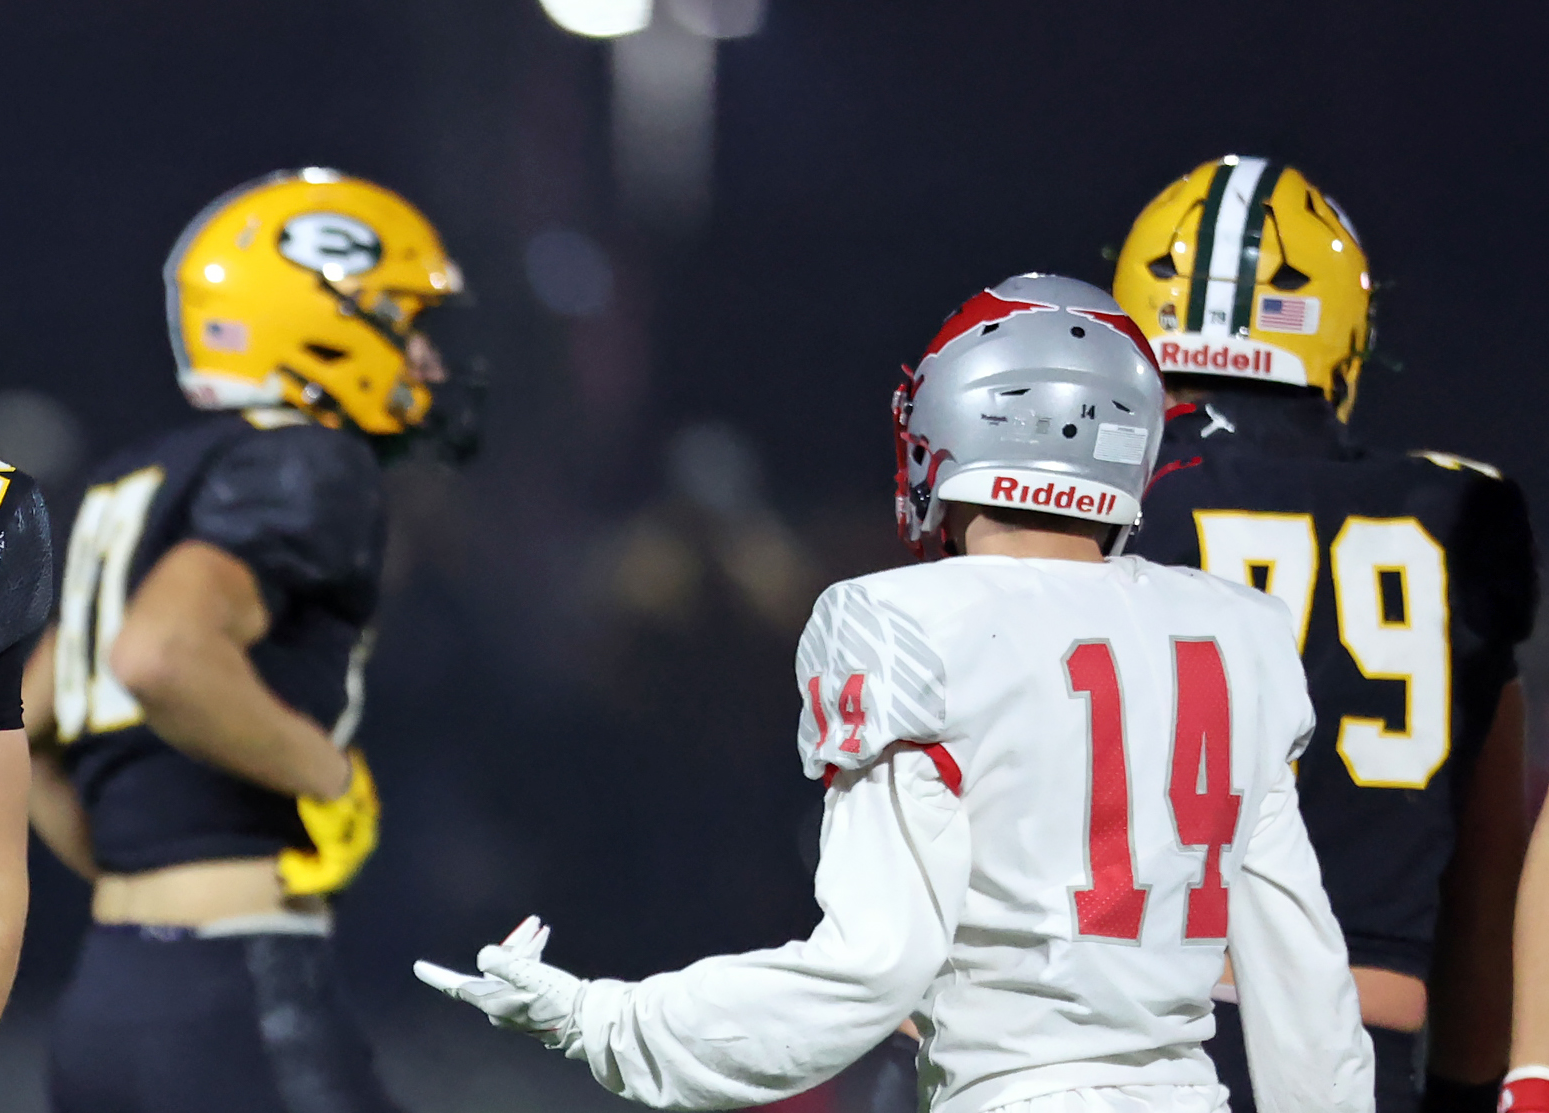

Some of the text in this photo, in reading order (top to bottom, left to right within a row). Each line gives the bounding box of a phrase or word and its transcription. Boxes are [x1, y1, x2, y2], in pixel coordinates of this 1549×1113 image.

[1161, 343, 1271, 374] Riddell
[1081, 404, 1096, 419] 14
[991, 476, 1117, 516] Riddell
[1192, 508, 1452, 789] 79
[807, 673, 866, 754] 14
[1060, 635, 1245, 946] 14
